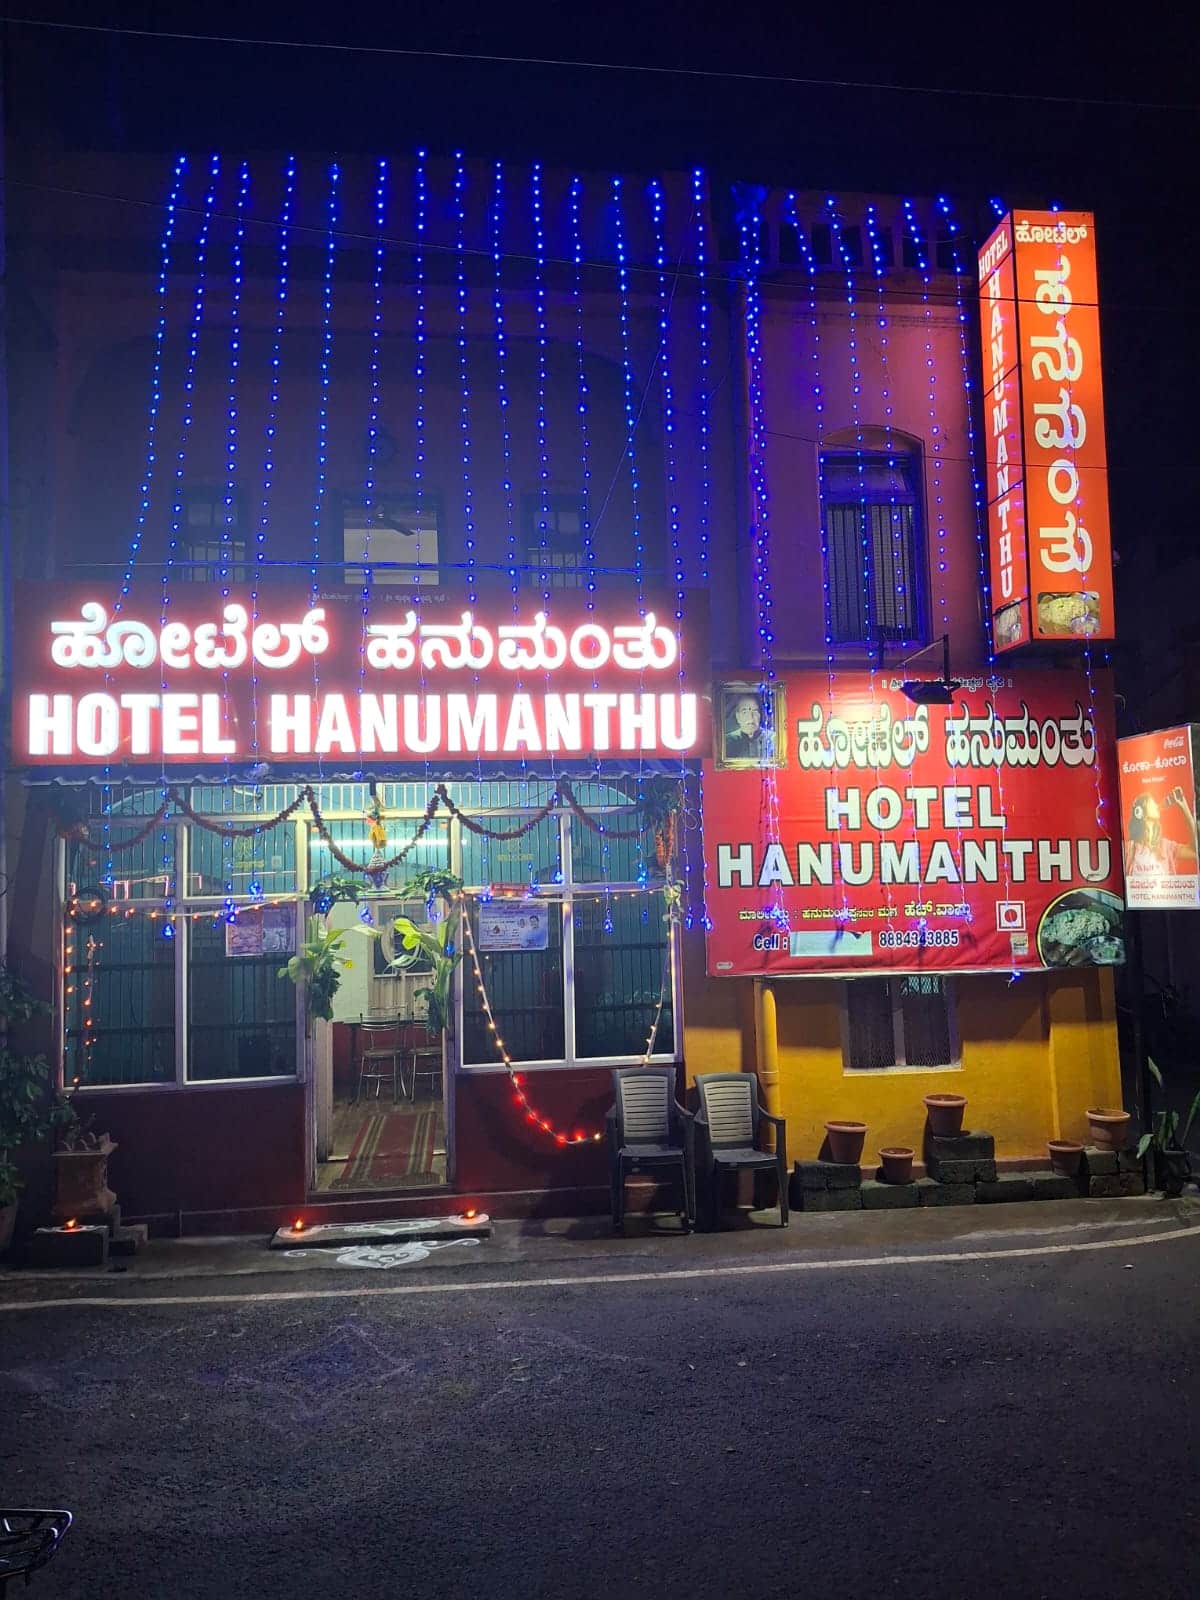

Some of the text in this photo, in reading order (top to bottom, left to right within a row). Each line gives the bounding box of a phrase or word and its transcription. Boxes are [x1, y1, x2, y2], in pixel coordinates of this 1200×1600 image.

[979, 229, 1009, 282] HOTEL
[1015, 219, 1088, 244] ಹೋಟೆಲ್
[988, 269, 1013, 598] HANUMANTHU
[1030, 254, 1093, 573] ಹನುಮಂತು
[50, 601, 679, 671] ಹೋಟೆಲ್ ಹನುಮಂತು
[28, 692, 699, 756] HOTEL HANUMANTHU
[797, 701, 1097, 770] ಹೋಟೆಲ್ ಹನುಮಂತು
[824, 784, 1008, 831] HOTEL
[716, 838, 1112, 888] HANUMANTHU
[753, 933, 779, 951] Cell
[879, 930, 959, 948] 8884343885
